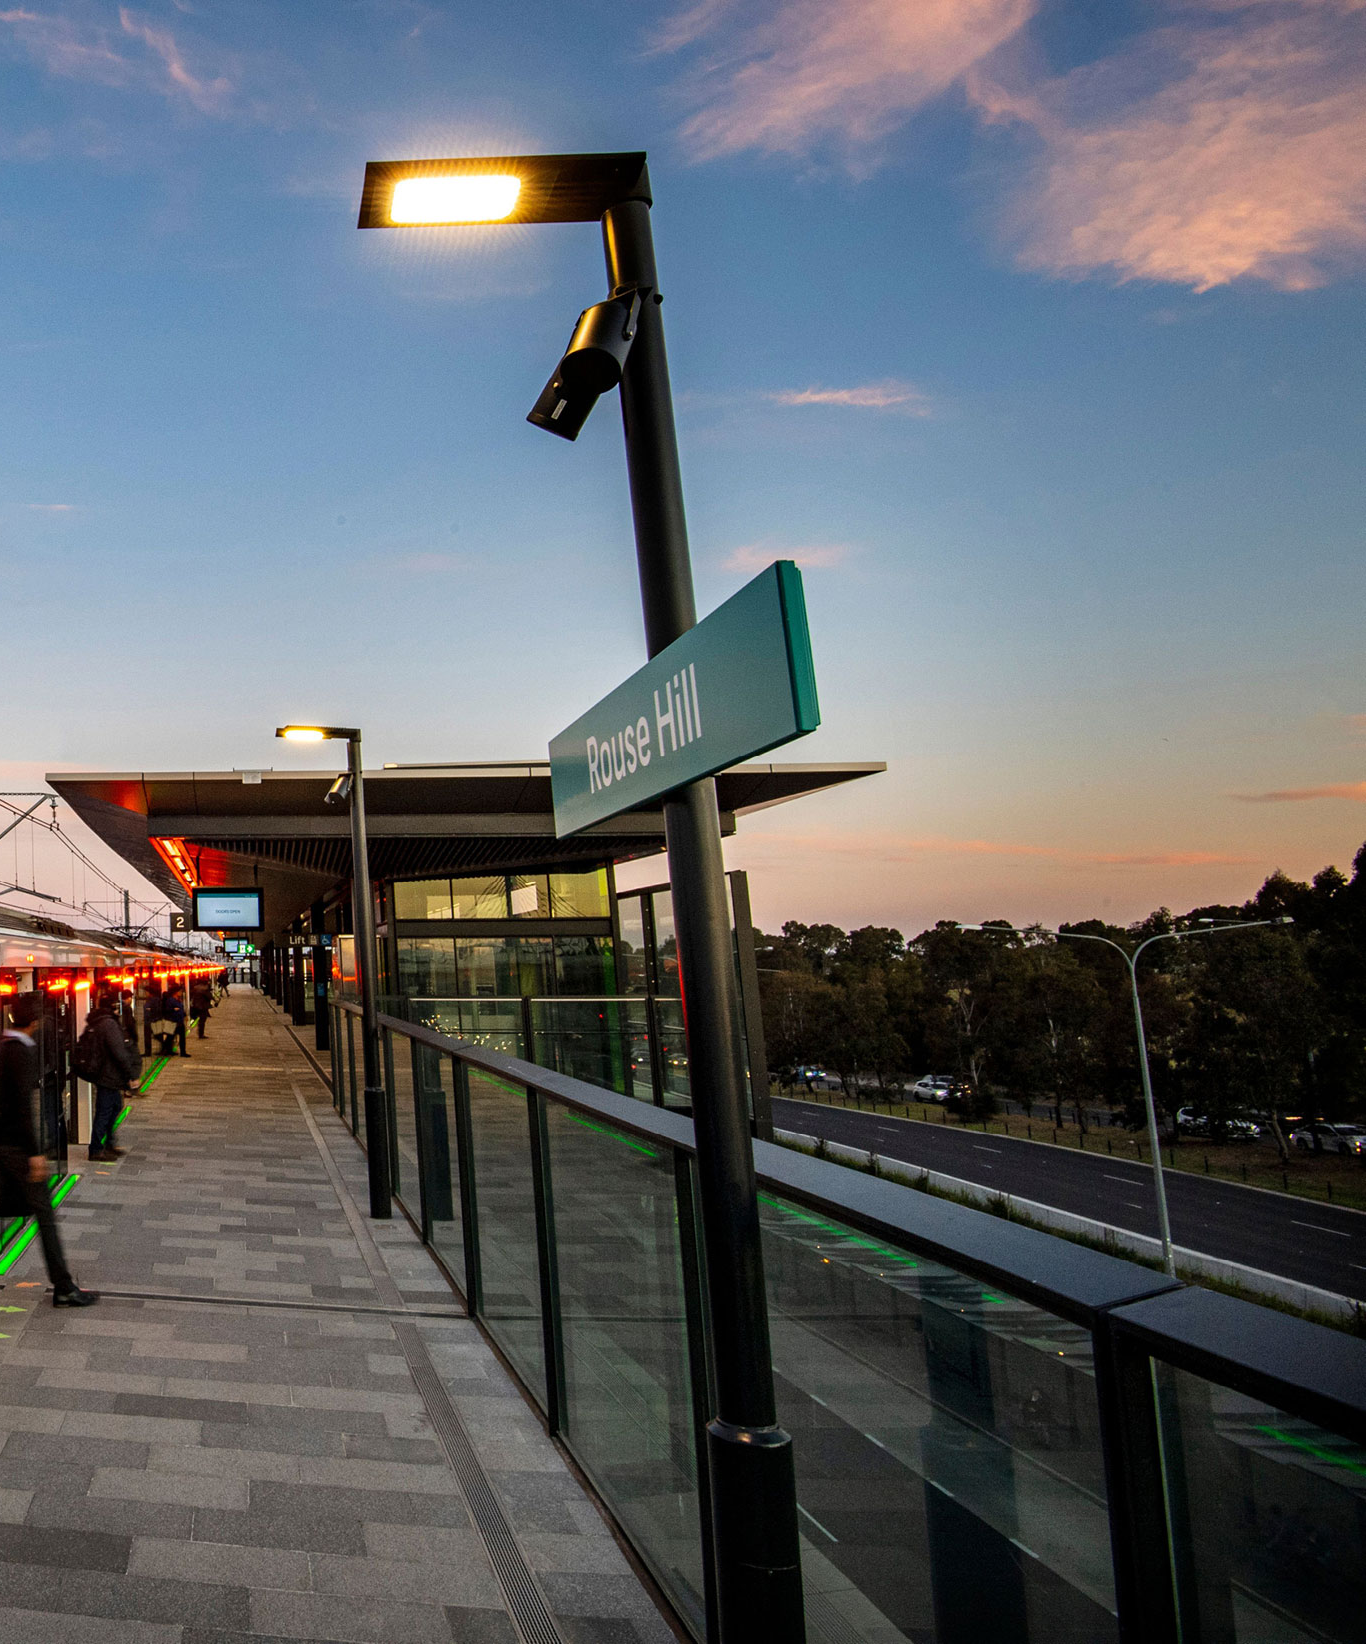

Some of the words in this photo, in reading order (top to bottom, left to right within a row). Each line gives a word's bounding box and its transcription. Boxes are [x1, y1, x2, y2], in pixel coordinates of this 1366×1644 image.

[586, 715, 651, 794] Rouse
[654, 662, 702, 757] Hill
[176, 916, 185, 928] 2
[289, 936, 306, 945] Lift
